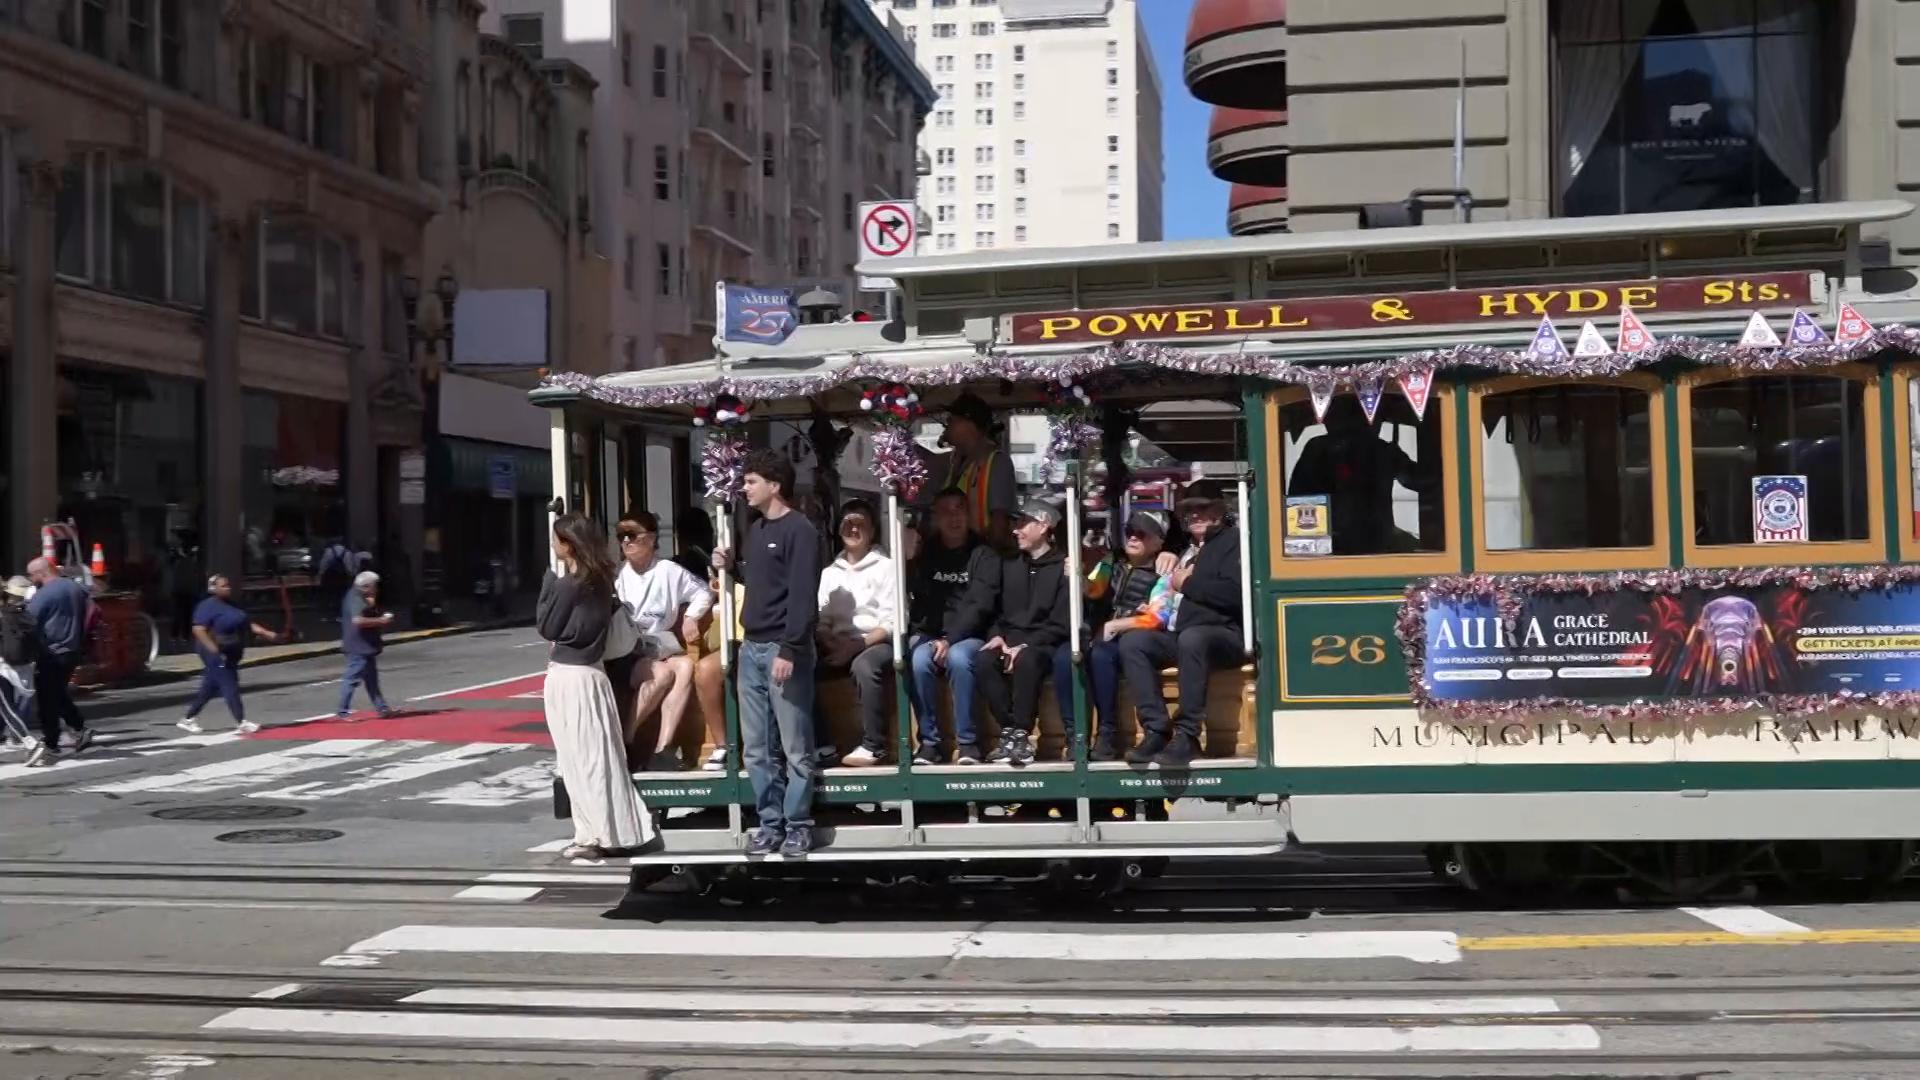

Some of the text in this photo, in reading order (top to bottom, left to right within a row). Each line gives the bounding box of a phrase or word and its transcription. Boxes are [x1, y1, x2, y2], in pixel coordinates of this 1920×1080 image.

[1039, 279, 1791, 339] POWELL & HYDE Sts.
[1553, 613, 1609, 629] GRACE
[1433, 616, 1550, 649] AURA
[1553, 630, 1654, 647] CATHEDRAL
[1311, 634, 1386, 665] 26
[1802, 639, 1826, 649] GET
[1829, 638, 1876, 648] TICKETS
[1877, 637, 1893, 647] AT
[1372, 719, 1653, 748] MUNICIPAL
[843, 784, 868, 793] ONLY
[945, 782, 968, 790] TWO
[1019, 780, 1045, 788] ONLY
[1119, 778, 1142, 787] TWO
[1196, 777, 1222, 786] ONLY
[688, 787, 712, 796] ONLY
